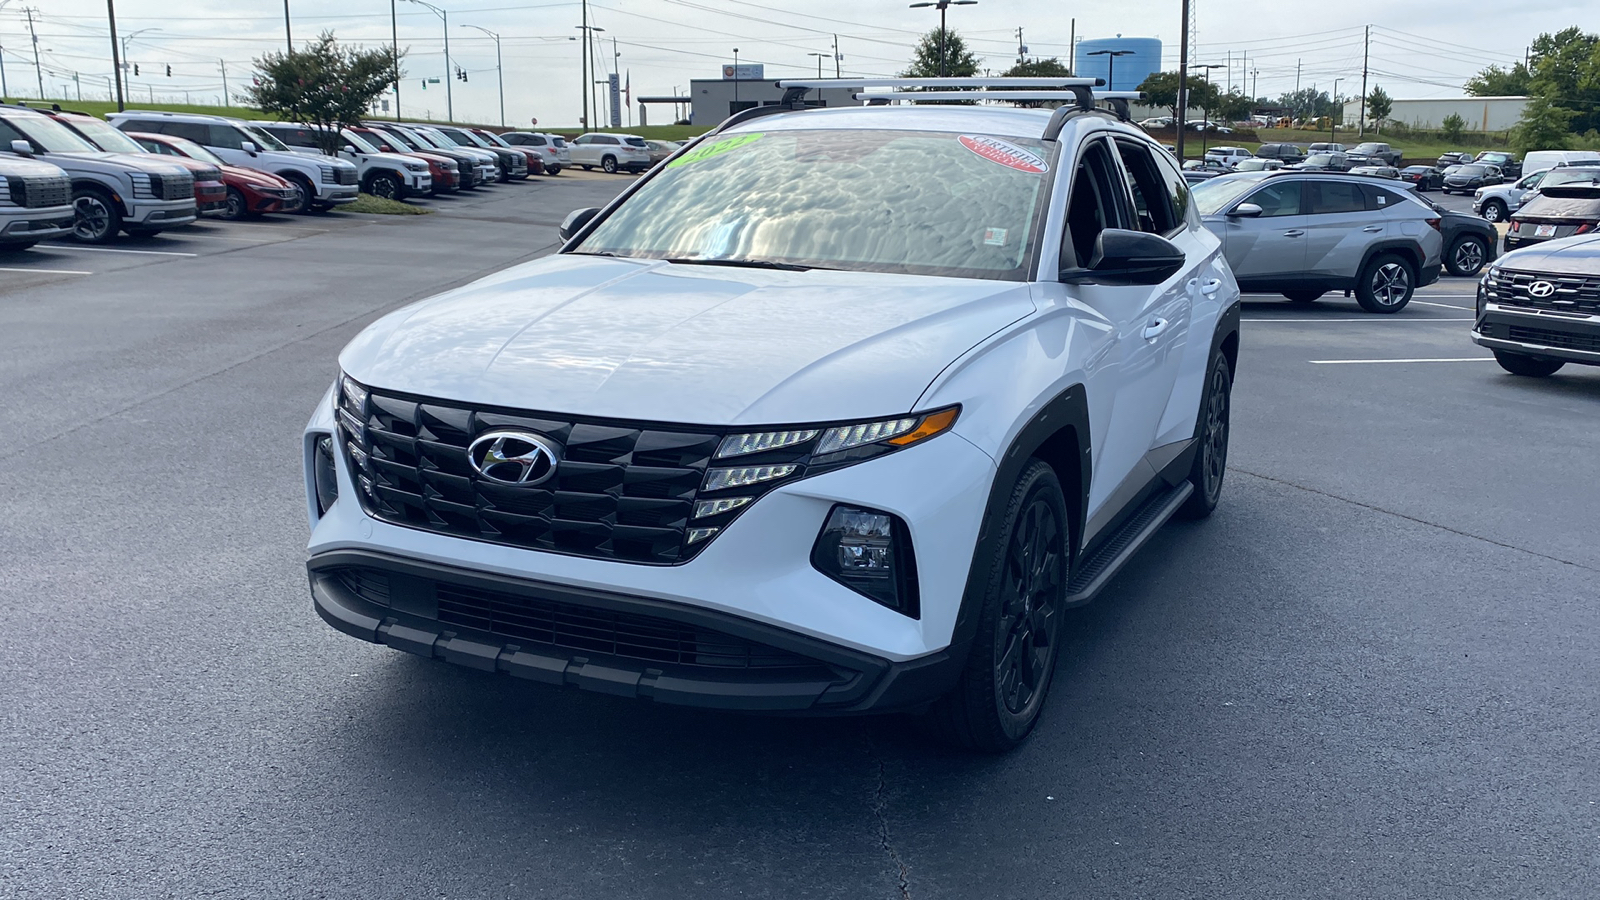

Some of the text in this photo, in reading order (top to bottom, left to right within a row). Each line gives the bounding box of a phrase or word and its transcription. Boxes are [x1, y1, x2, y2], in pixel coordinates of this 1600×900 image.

[683, 136, 748, 163] 2022
[973, 136, 1043, 167] CERTIFIED
[974, 144, 1015, 166] VEHICLE
